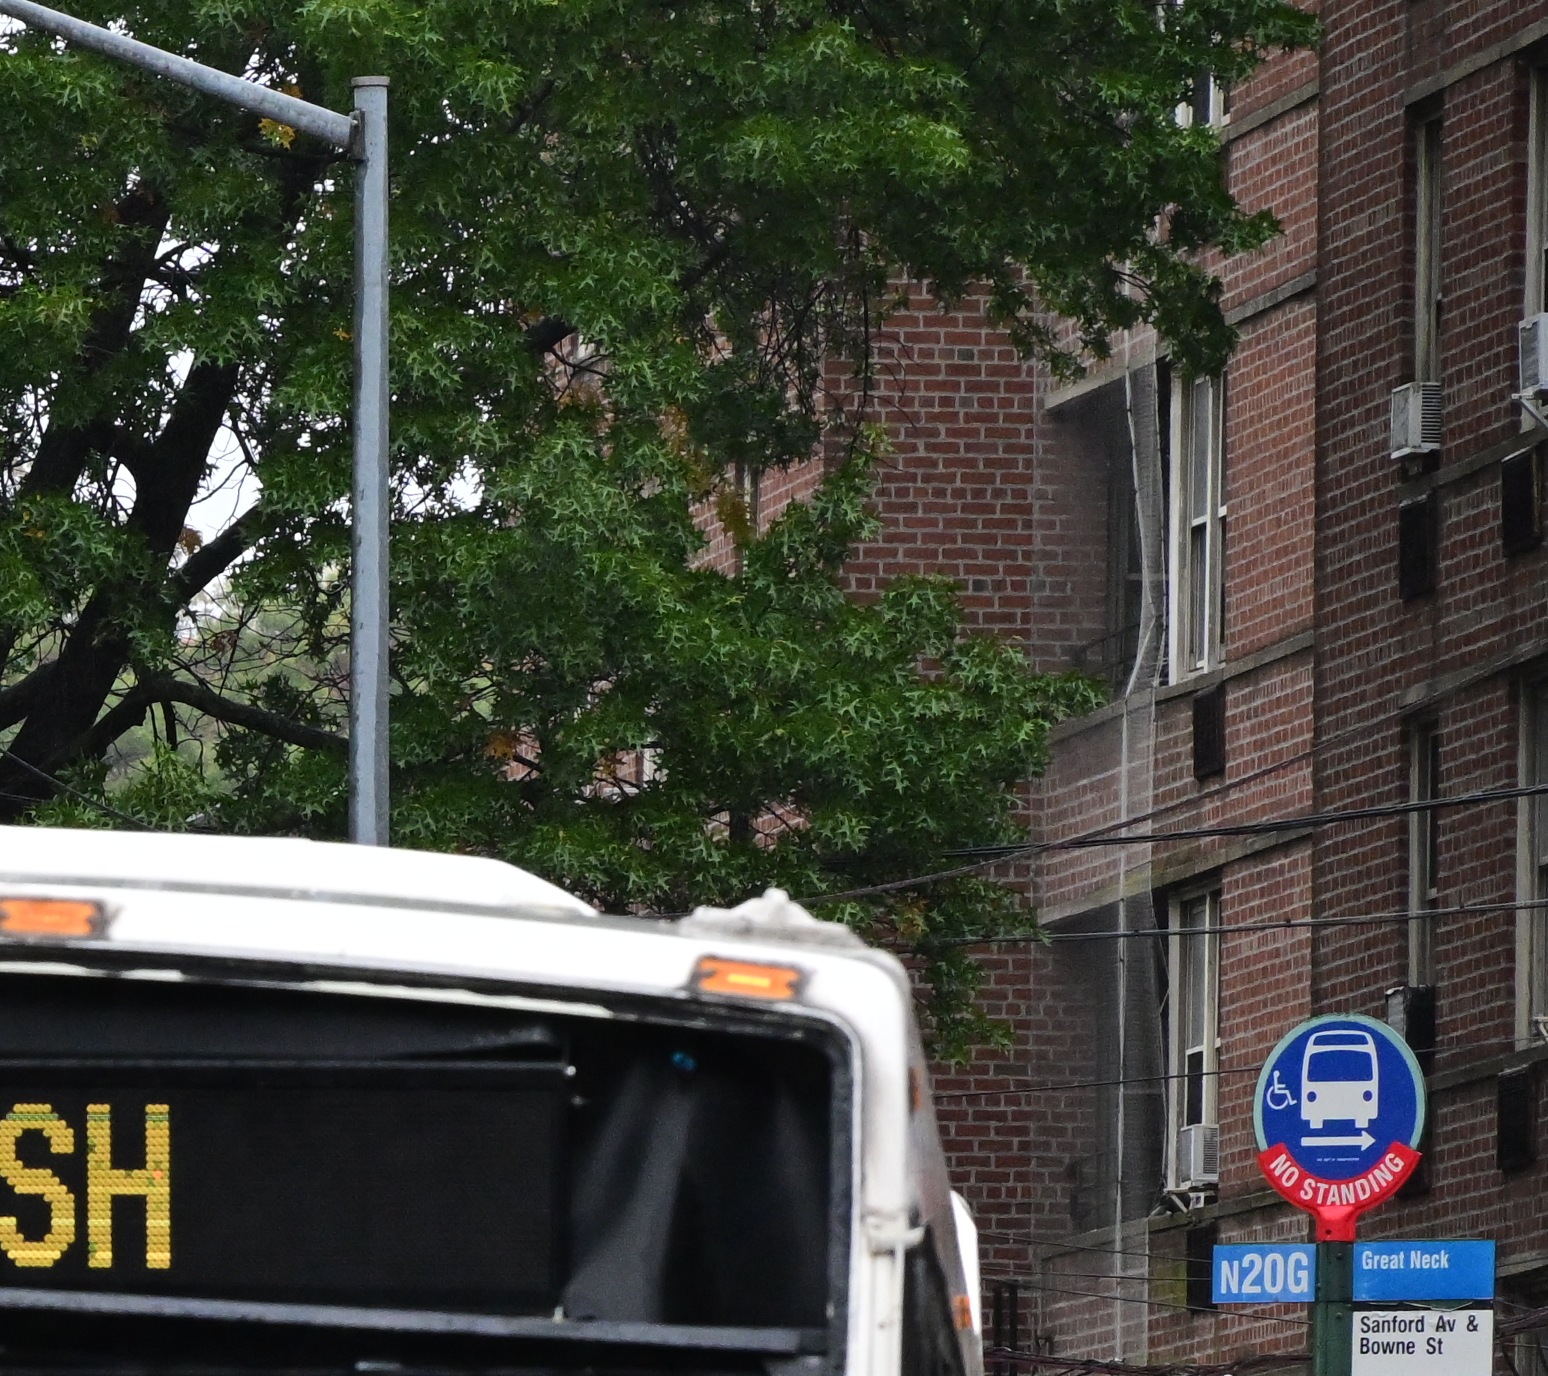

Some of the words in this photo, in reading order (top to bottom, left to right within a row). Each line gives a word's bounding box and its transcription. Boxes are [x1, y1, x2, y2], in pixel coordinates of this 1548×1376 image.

[1270, 1154, 1300, 1187] NO
[1300, 1154, 1406, 1206] STANDING
[1361, 1250, 1404, 1270] Great
[1410, 1250, 1449, 1269] Neck
[1220, 1252, 1309, 1294] N20G
[1360, 1315, 1425, 1334] Sanford
[1435, 1315, 1456, 1332] Av
[1466, 1315, 1479, 1332] &
[1359, 1337, 1416, 1355] Bowne
[1426, 1336, 1444, 1355] St
